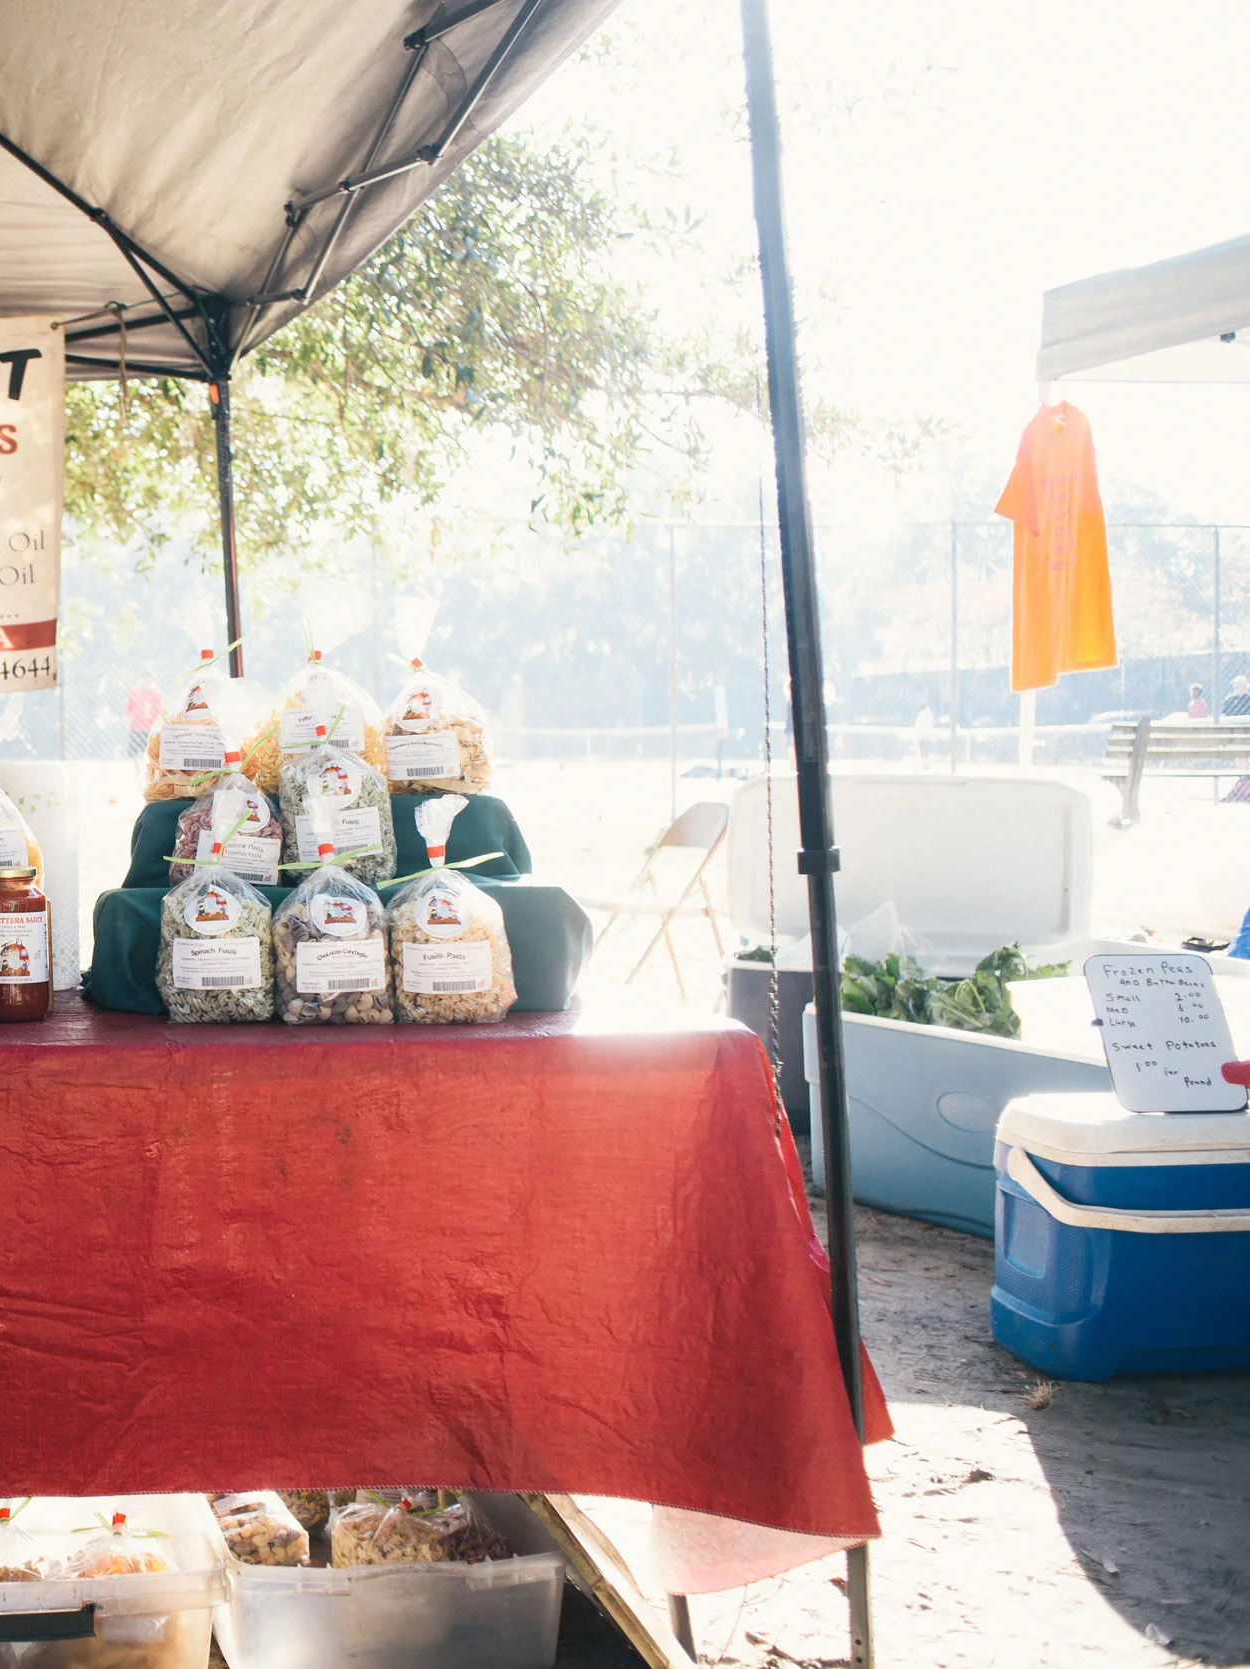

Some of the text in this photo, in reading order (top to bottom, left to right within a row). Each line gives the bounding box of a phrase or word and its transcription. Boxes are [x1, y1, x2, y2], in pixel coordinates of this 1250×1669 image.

[8, 530, 46, 553] Oil
[25, 916, 43, 924] SAUCE
[191, 947, 237, 957] Spinach Fusilli
[316, 949, 342, 961] Chocolate
[422, 952, 466, 960] Fusilli Pasta
[1103, 961, 1193, 979] Frozen Peas
[1105, 993, 1141, 1003] Small
[1112, 1040, 1217, 1051] Sweet Potatoes
[1184, 1076, 1212, 1088] Pound
